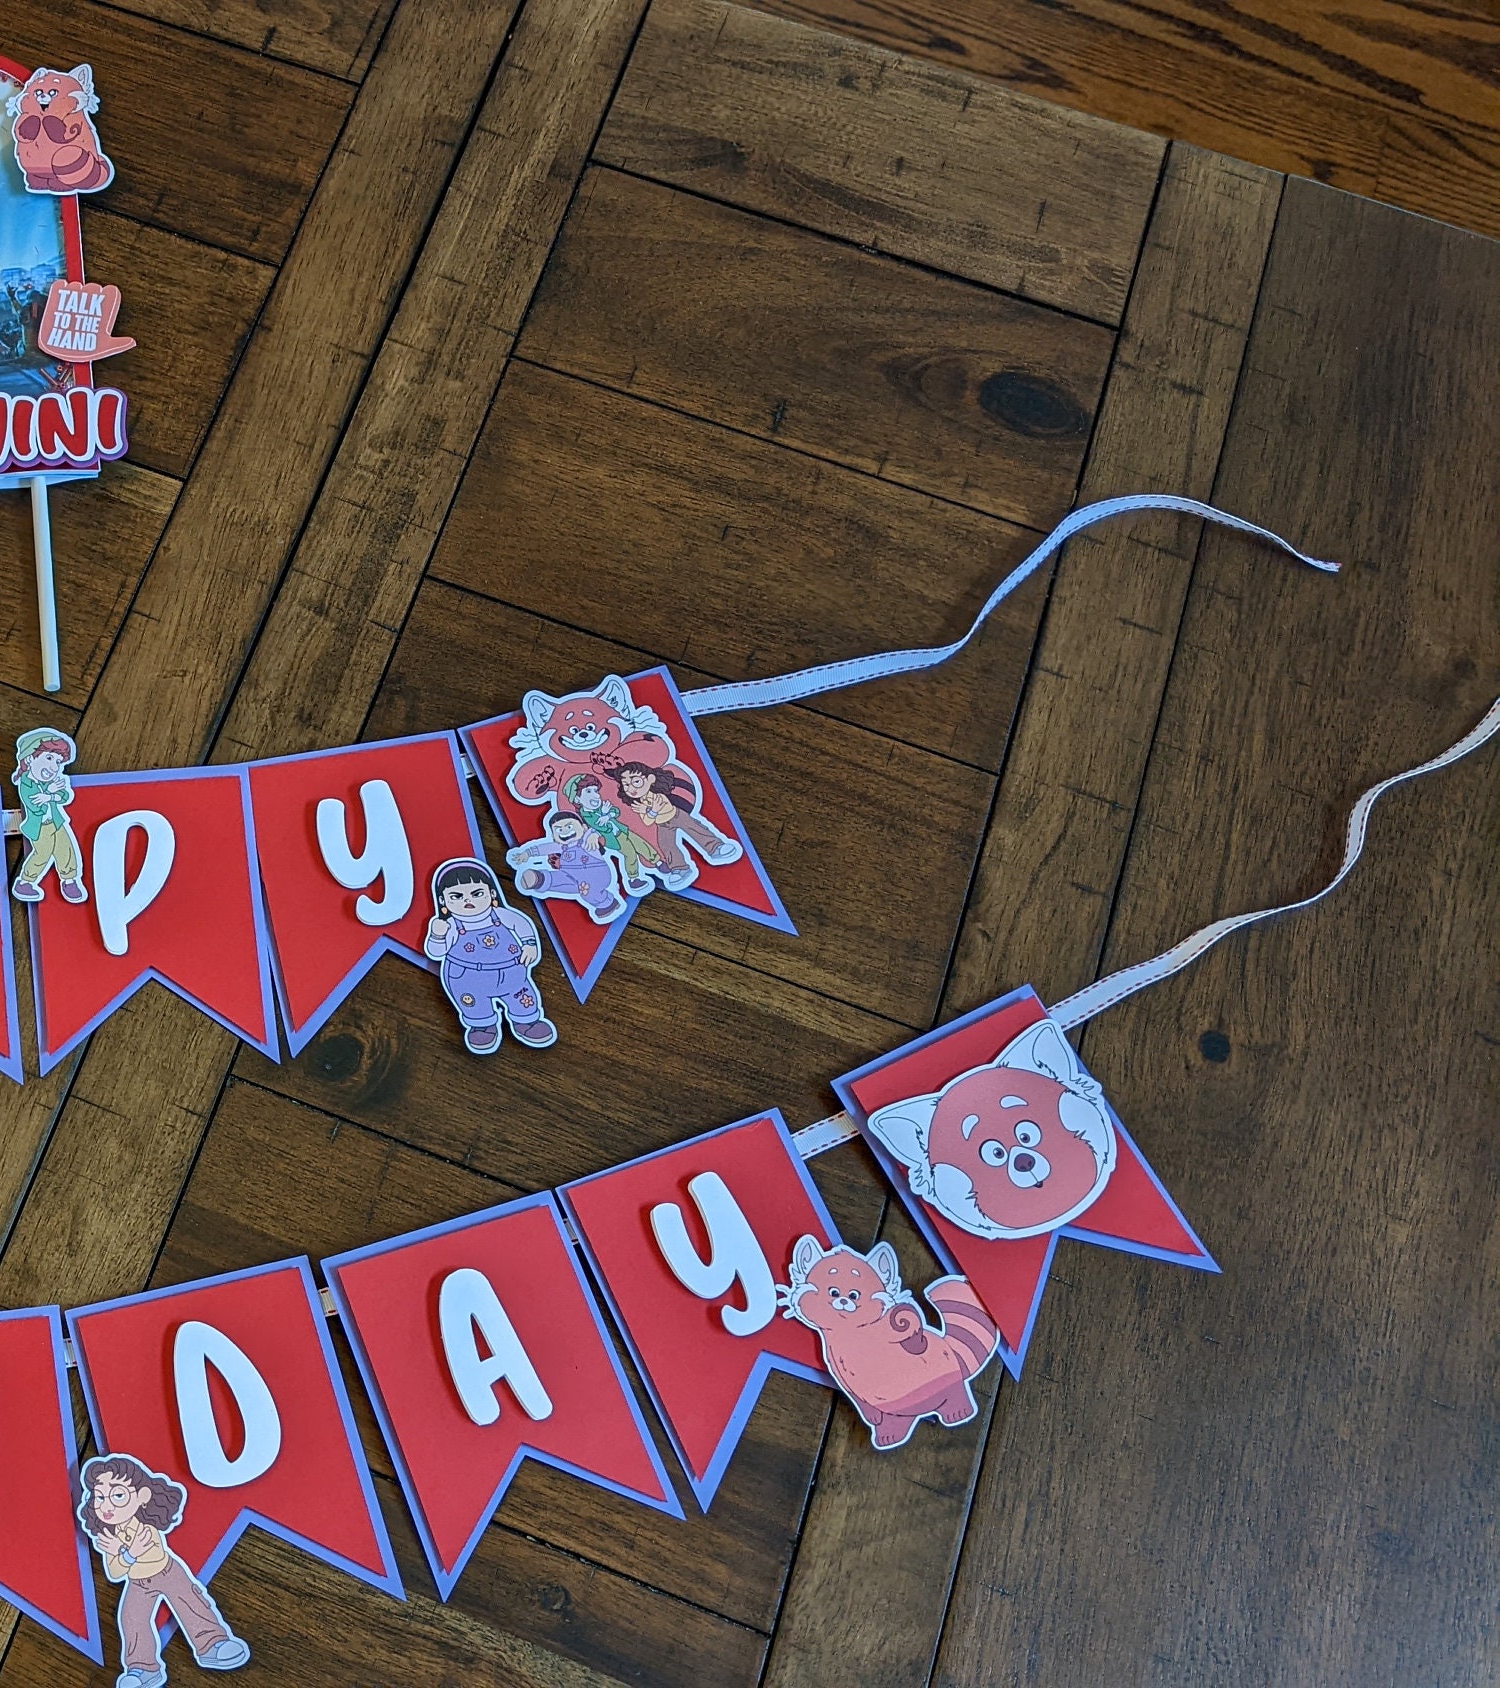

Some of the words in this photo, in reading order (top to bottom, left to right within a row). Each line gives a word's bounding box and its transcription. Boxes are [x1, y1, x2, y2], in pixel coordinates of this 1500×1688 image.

[57, 289, 106, 317] TALK
[53, 311, 71, 330] TO
[74, 314, 102, 333] THE
[46, 328, 97, 352] HAND
